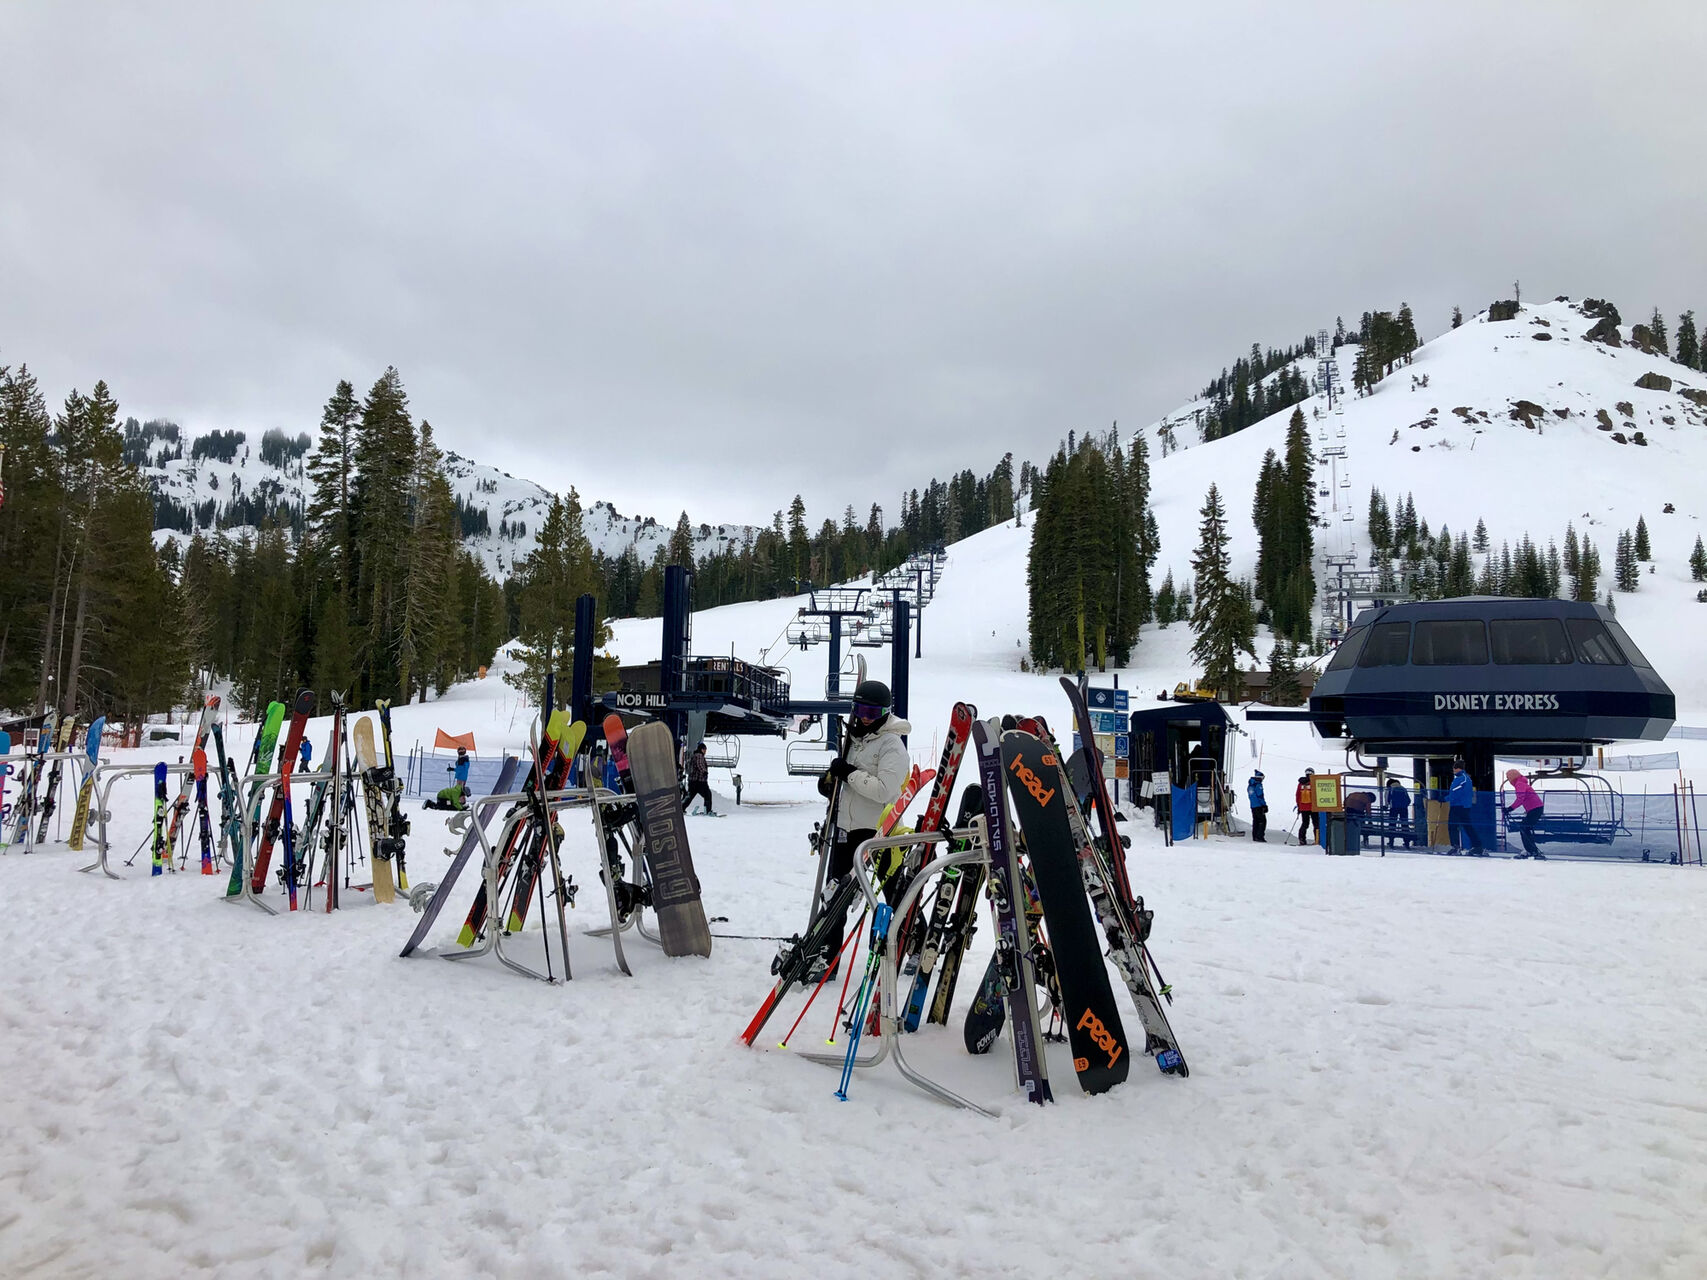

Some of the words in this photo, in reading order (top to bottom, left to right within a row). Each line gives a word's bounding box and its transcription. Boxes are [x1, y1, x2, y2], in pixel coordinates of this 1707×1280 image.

[713, 661, 744, 672] RENLS
[616, 694, 642, 706] NOB
[645, 694, 667, 707] HILL
[1434, 694, 1490, 710] DISNEY
[1495, 694, 1560, 710] EXPRESS
[1009, 752, 1056, 808] head
[986, 771, 1001, 851] SALOMON
[644, 793, 695, 900] GILSON
